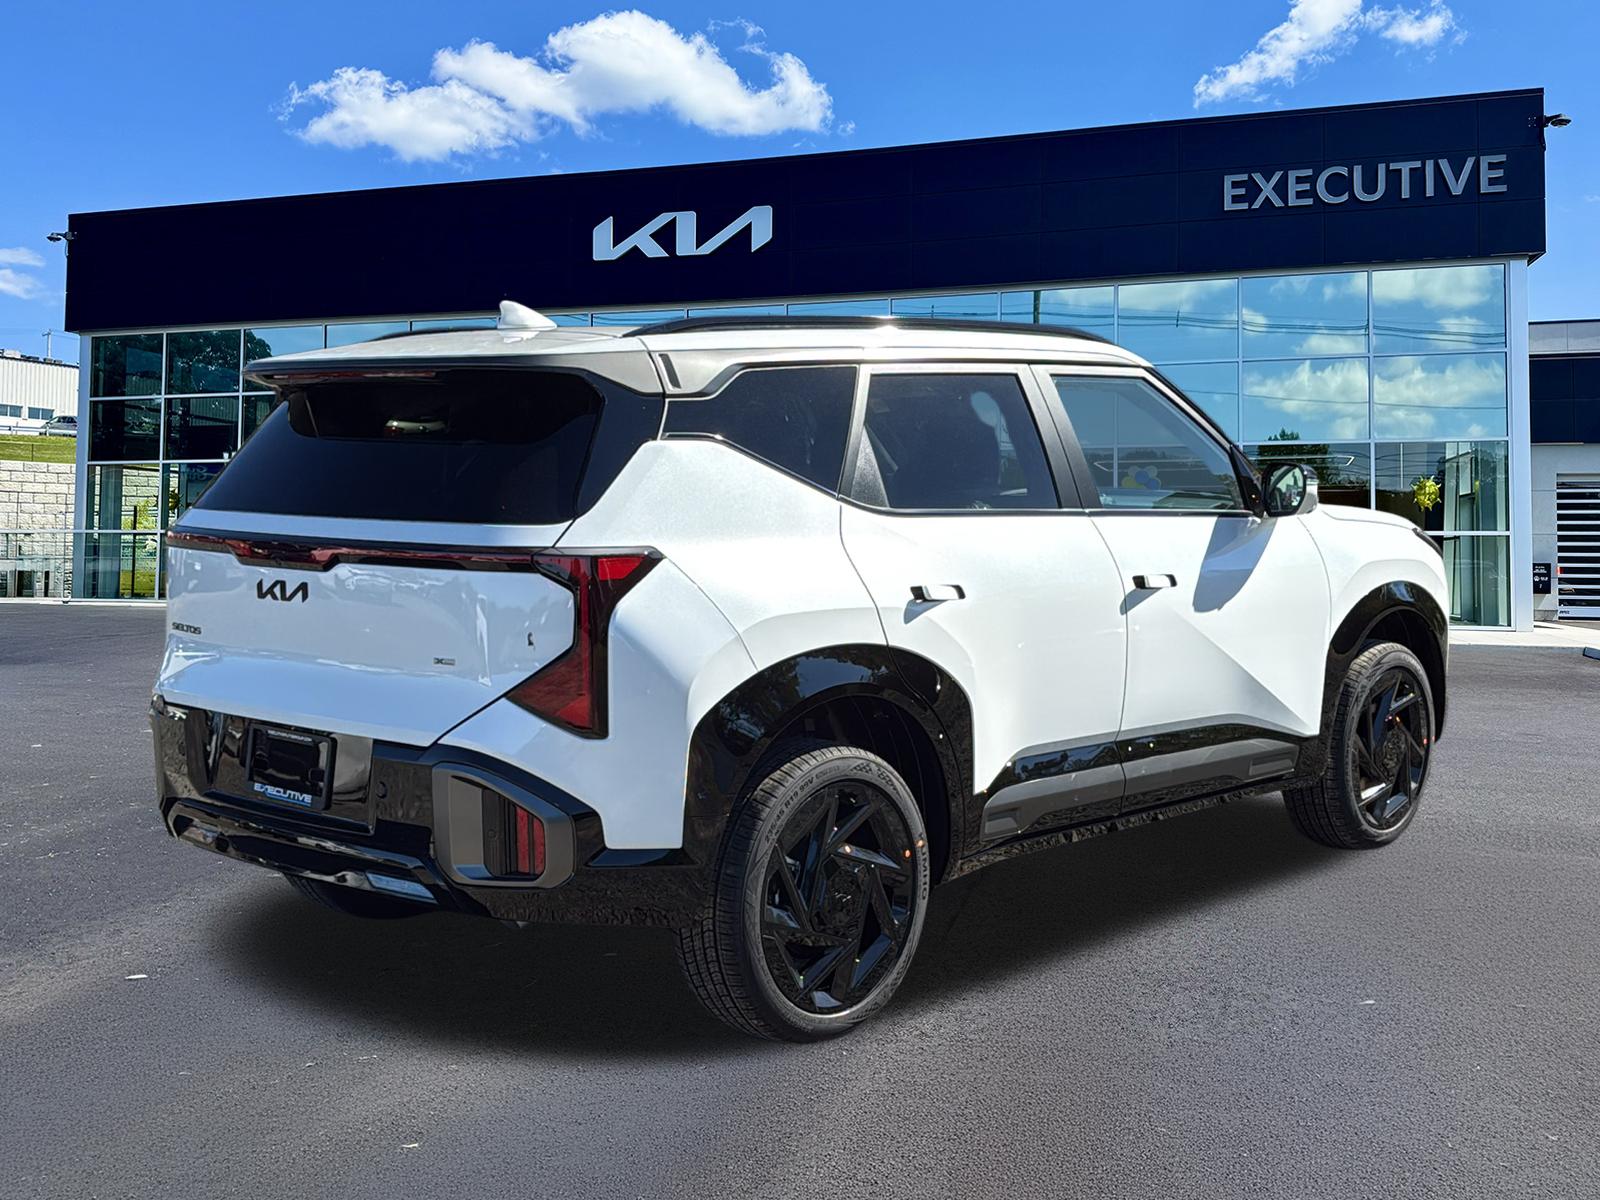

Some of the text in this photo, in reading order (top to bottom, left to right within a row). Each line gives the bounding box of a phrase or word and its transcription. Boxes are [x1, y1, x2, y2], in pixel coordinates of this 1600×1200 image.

[1223, 154, 1508, 212] EXECUTIVE
[592, 205, 773, 261] KIA
[257, 578, 309, 603] KIA
[171, 621, 202, 635] SELTOS
[253, 782, 313, 804] EXECUTIVE
